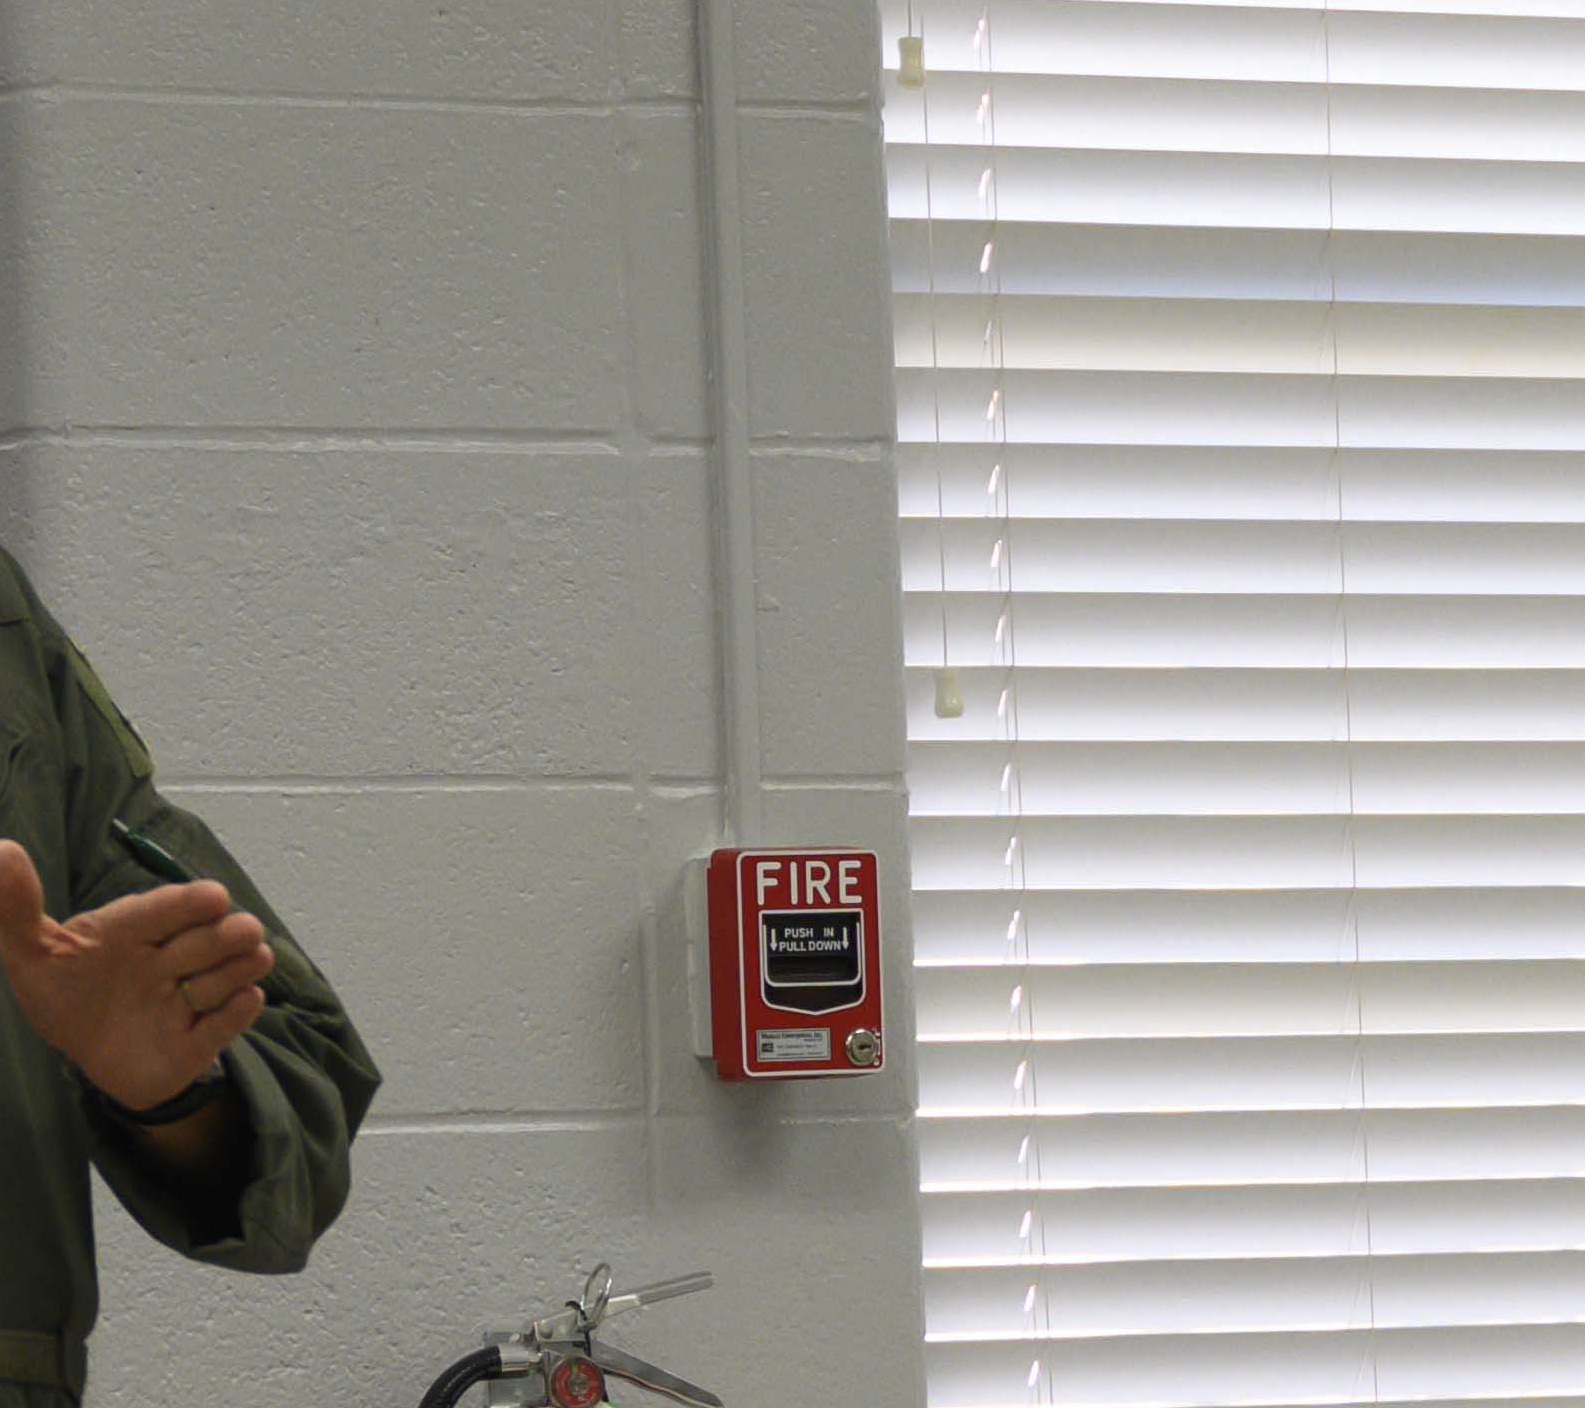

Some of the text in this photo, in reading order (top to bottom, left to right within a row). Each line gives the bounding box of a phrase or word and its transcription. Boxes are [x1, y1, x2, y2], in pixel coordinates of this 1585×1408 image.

[756, 860, 863, 906] FIRE
[783, 926, 835, 939] PUSH IN
[778, 940, 842, 952] PULL DOWN
